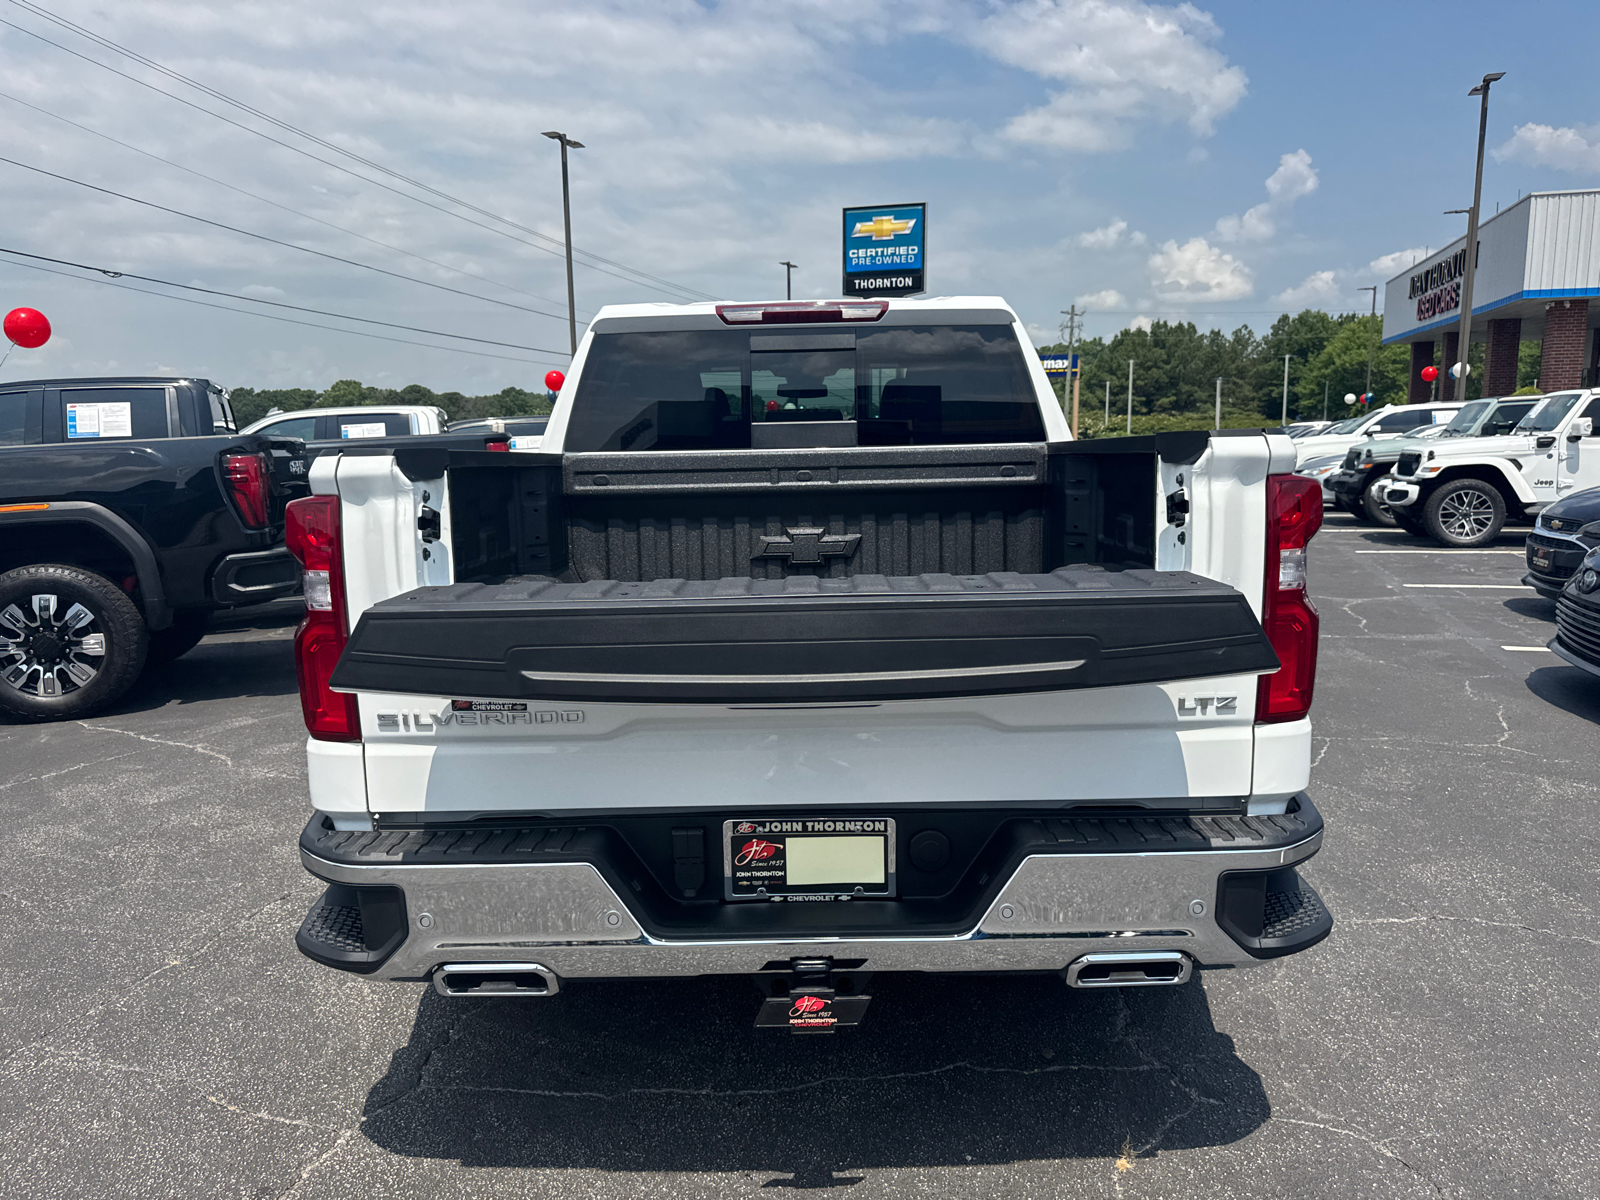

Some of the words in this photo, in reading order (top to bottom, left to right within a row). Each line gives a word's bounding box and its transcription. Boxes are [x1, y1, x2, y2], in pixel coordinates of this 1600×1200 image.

[849, 246, 918, 257] CERTIFIED
[852, 255, 914, 265] PRE-OWNED
[854, 277, 913, 289] THORNTON
[1042, 359, 1069, 369] max
[1178, 692, 1237, 712] LTZ
[376, 710, 585, 727] SILVERADO
[764, 821, 803, 832] JOHN
